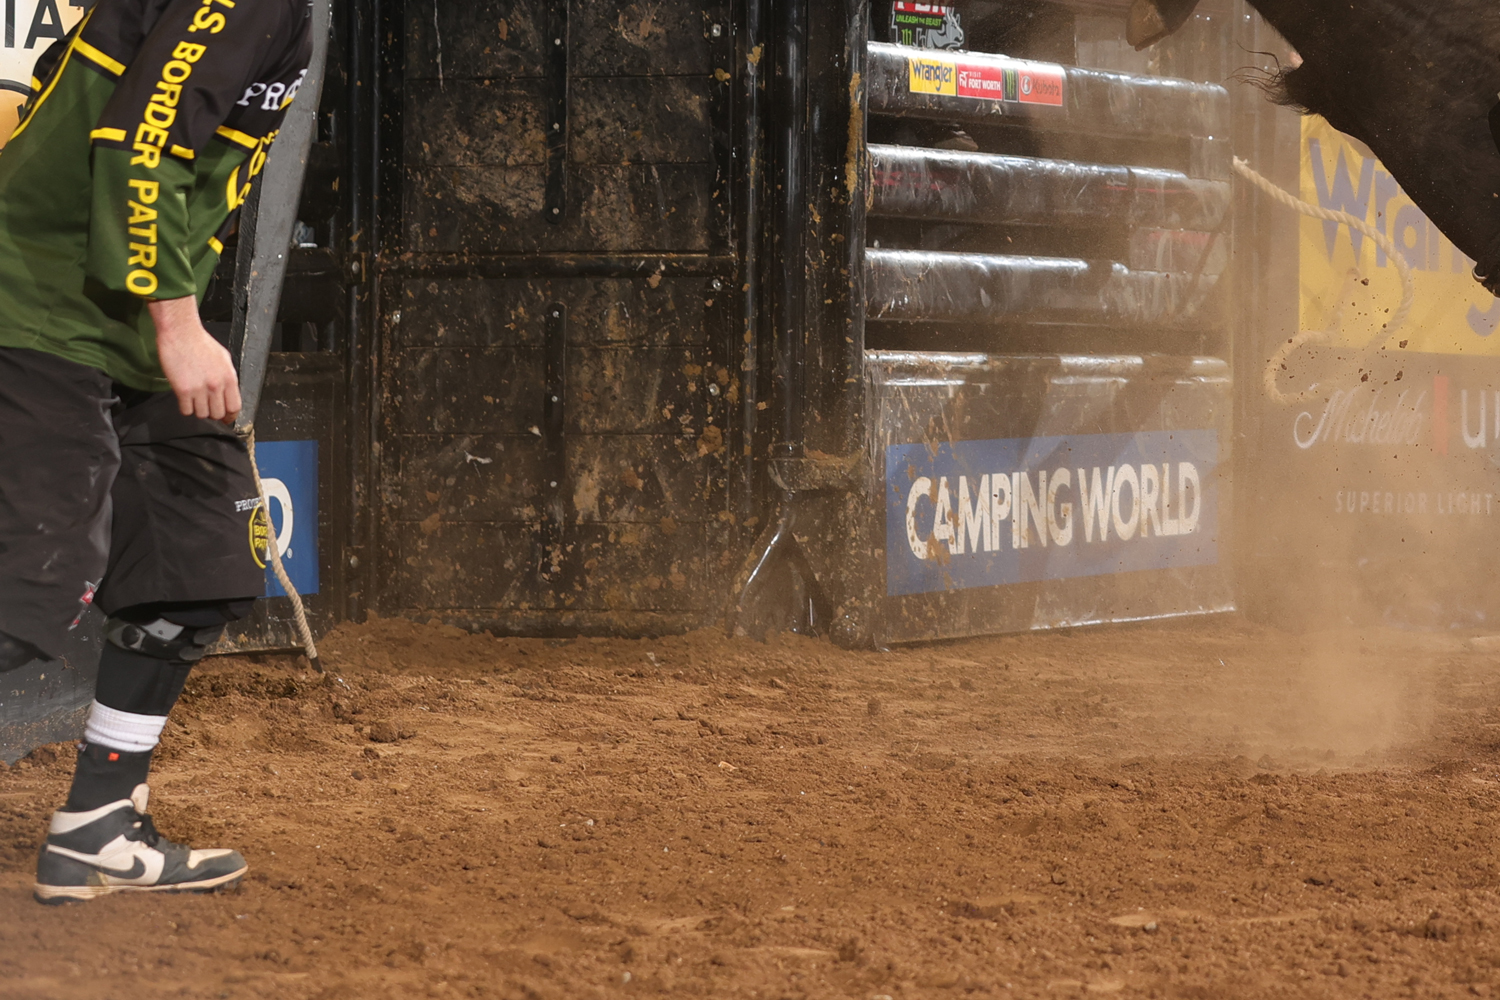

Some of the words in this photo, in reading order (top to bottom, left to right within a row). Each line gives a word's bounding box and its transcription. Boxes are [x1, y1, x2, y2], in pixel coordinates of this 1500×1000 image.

[130, 40, 207, 169] BORDER
[913, 60, 953, 91] Wrangler
[968, 78, 981, 89] FORT
[982, 80, 1001, 91] WORTH
[905, 467, 1073, 560] CAMPING
[1078, 462, 1201, 543] WORLD
